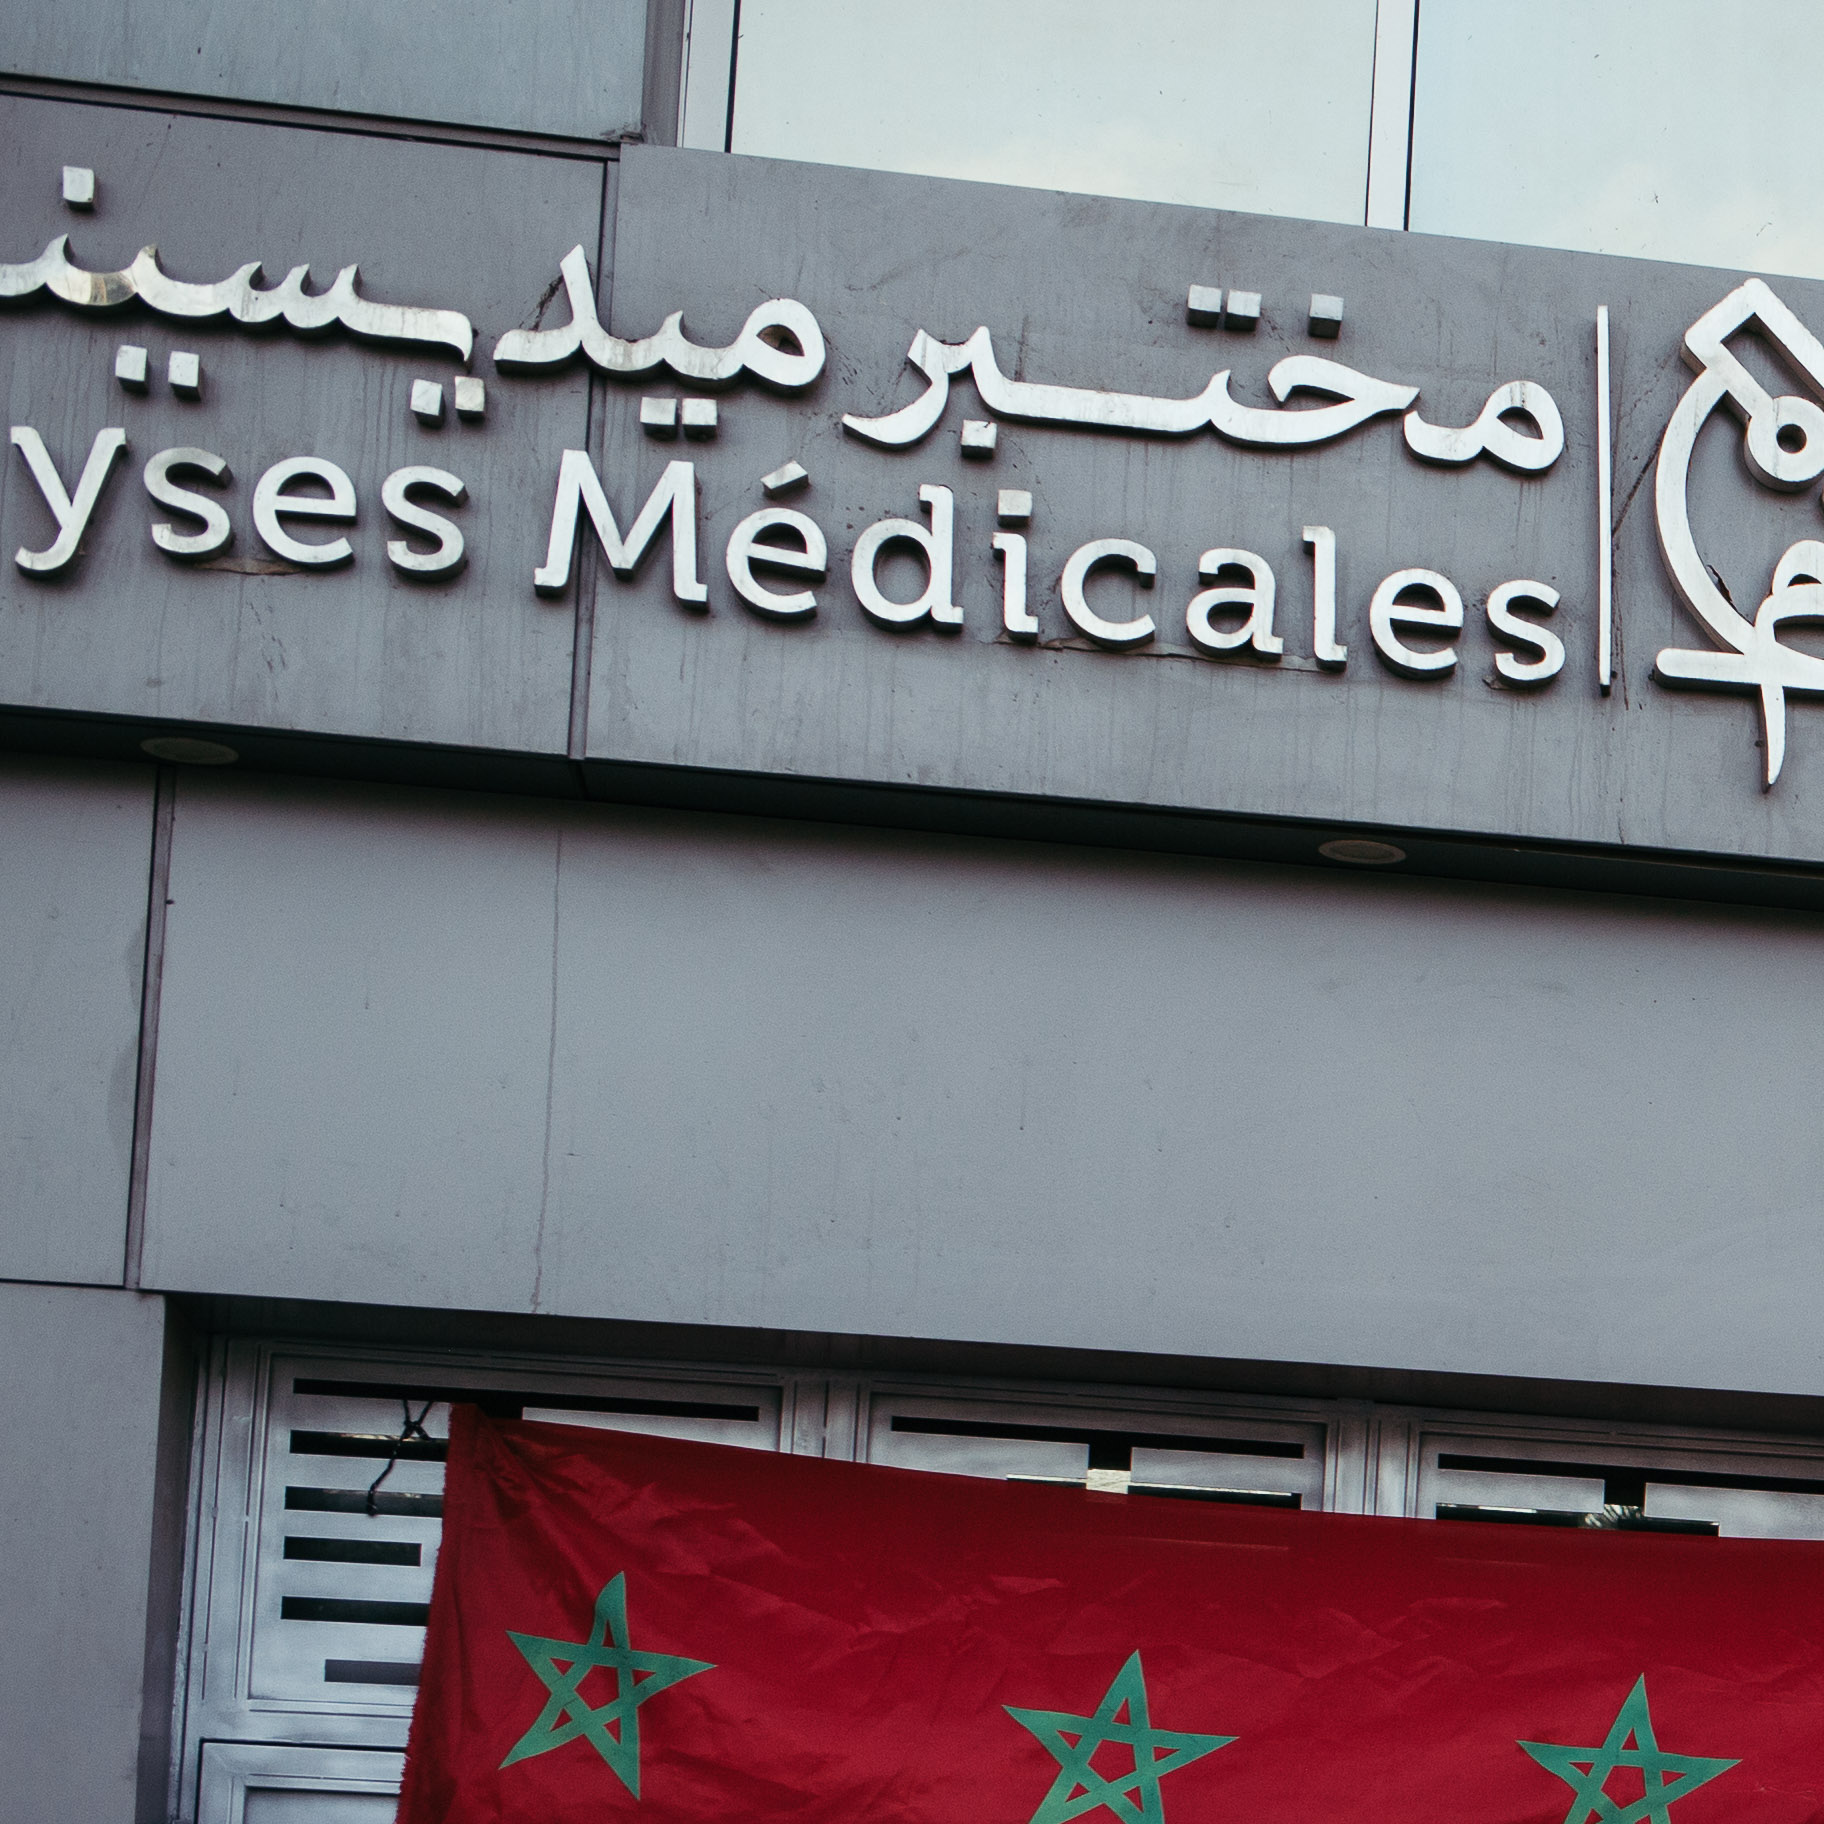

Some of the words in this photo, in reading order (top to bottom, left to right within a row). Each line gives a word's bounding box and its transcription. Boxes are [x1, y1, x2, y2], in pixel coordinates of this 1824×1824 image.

[0, 165, 826, 438] ميديسين
[841, 283, 1567, 472] مختبر
[10, 425, 470, 583] yses
[533, 448, 1566, 690] Médicales
